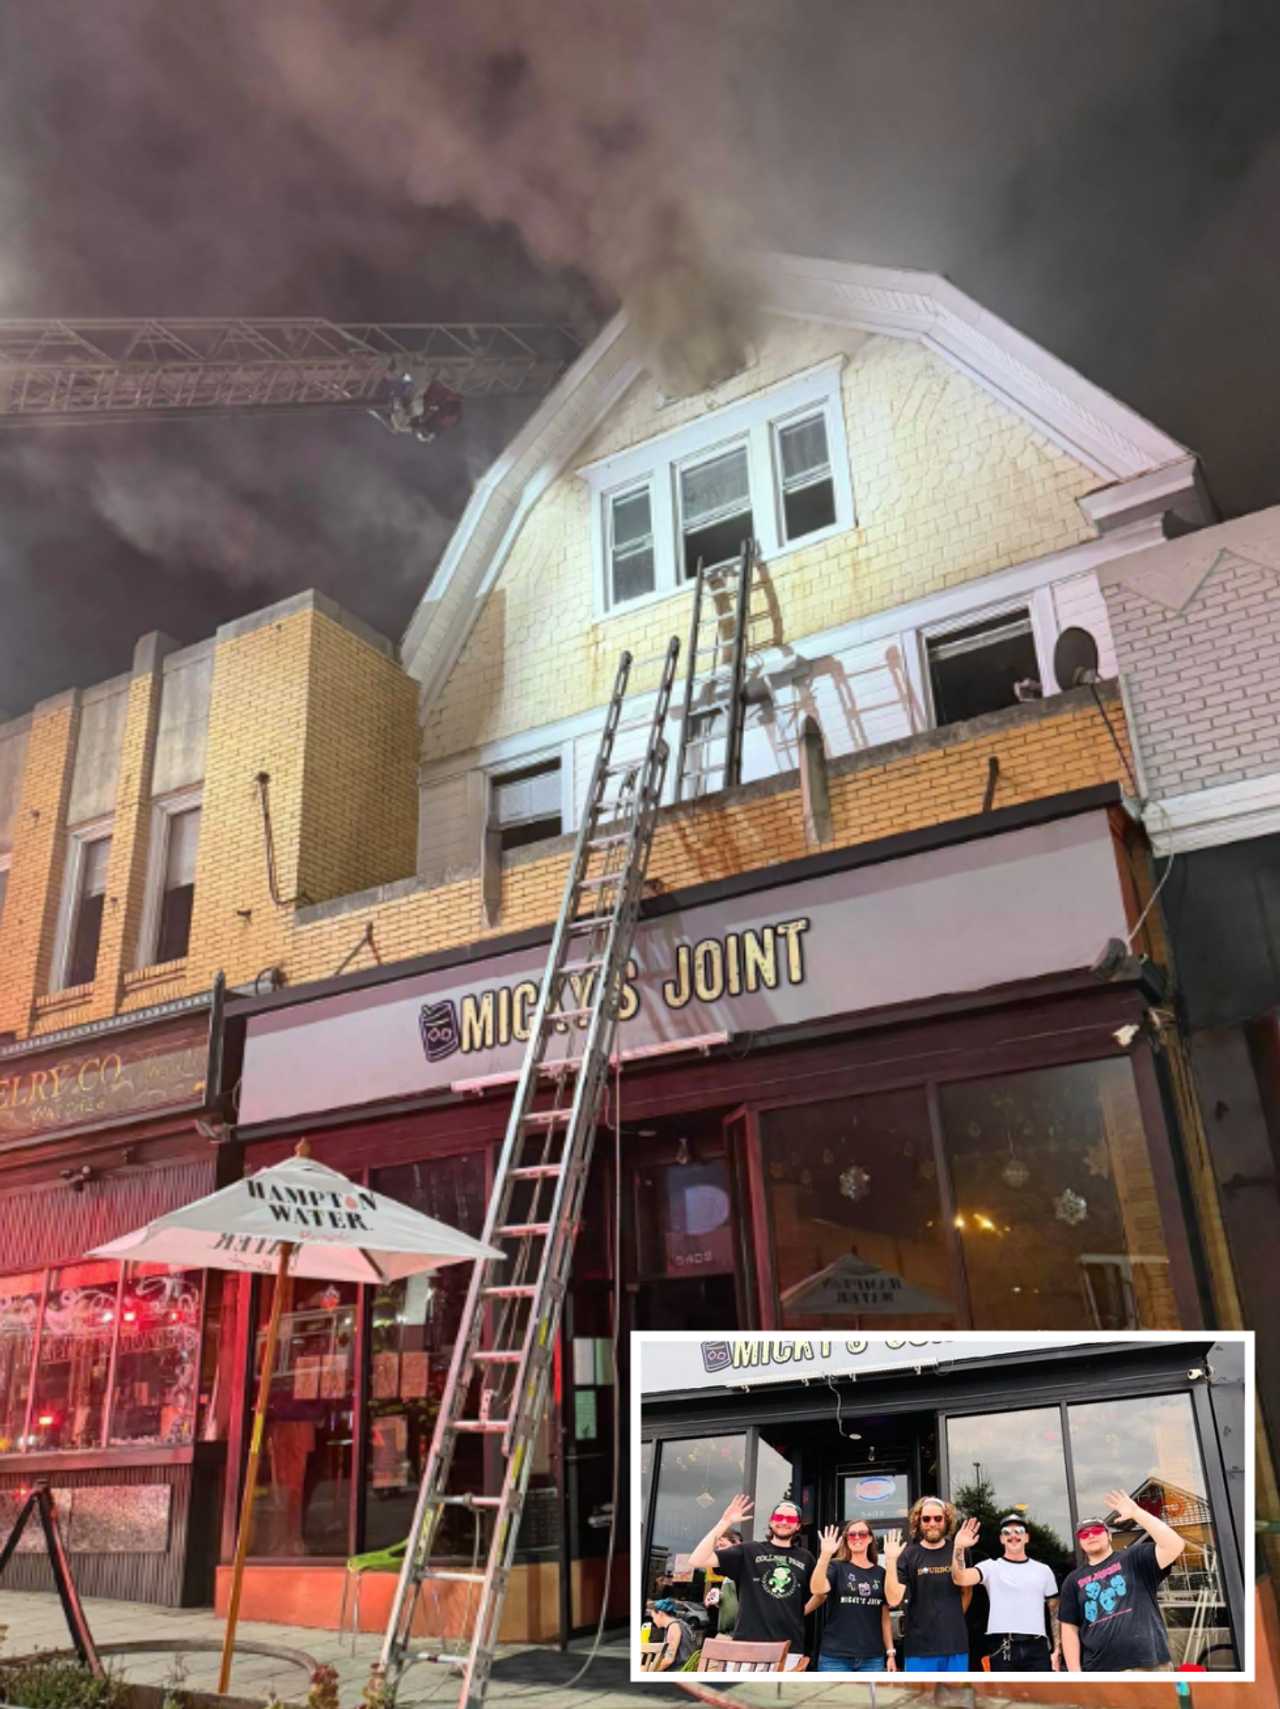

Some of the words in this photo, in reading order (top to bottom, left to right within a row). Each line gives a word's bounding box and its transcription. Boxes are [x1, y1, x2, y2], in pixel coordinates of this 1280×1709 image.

[459, 959, 640, 1053] MICYS
[664, 918, 809, 1009] JOINT
[247, 1180, 377, 1211] HAMPTON
[269, 1205, 368, 1230] WATER
